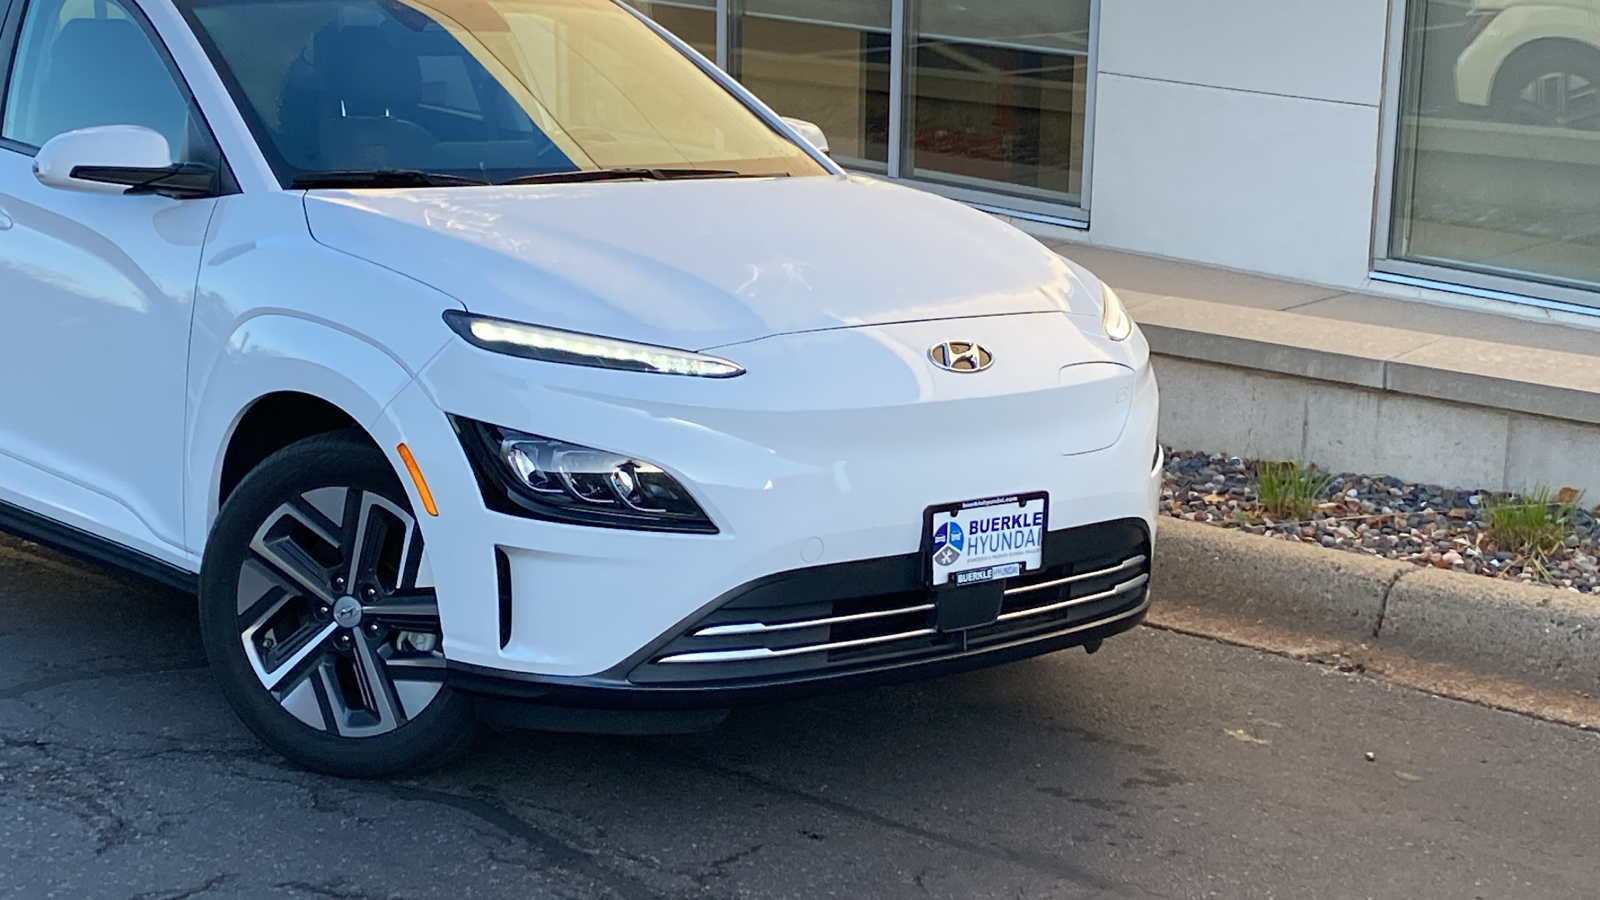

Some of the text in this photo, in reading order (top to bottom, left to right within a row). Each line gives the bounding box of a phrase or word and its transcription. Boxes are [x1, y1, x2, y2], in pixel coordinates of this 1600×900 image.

[969, 511, 1043, 535] BUERKLE
[967, 527, 1042, 556] HYUNDAI
[957, 569, 992, 584] BUERKLE
